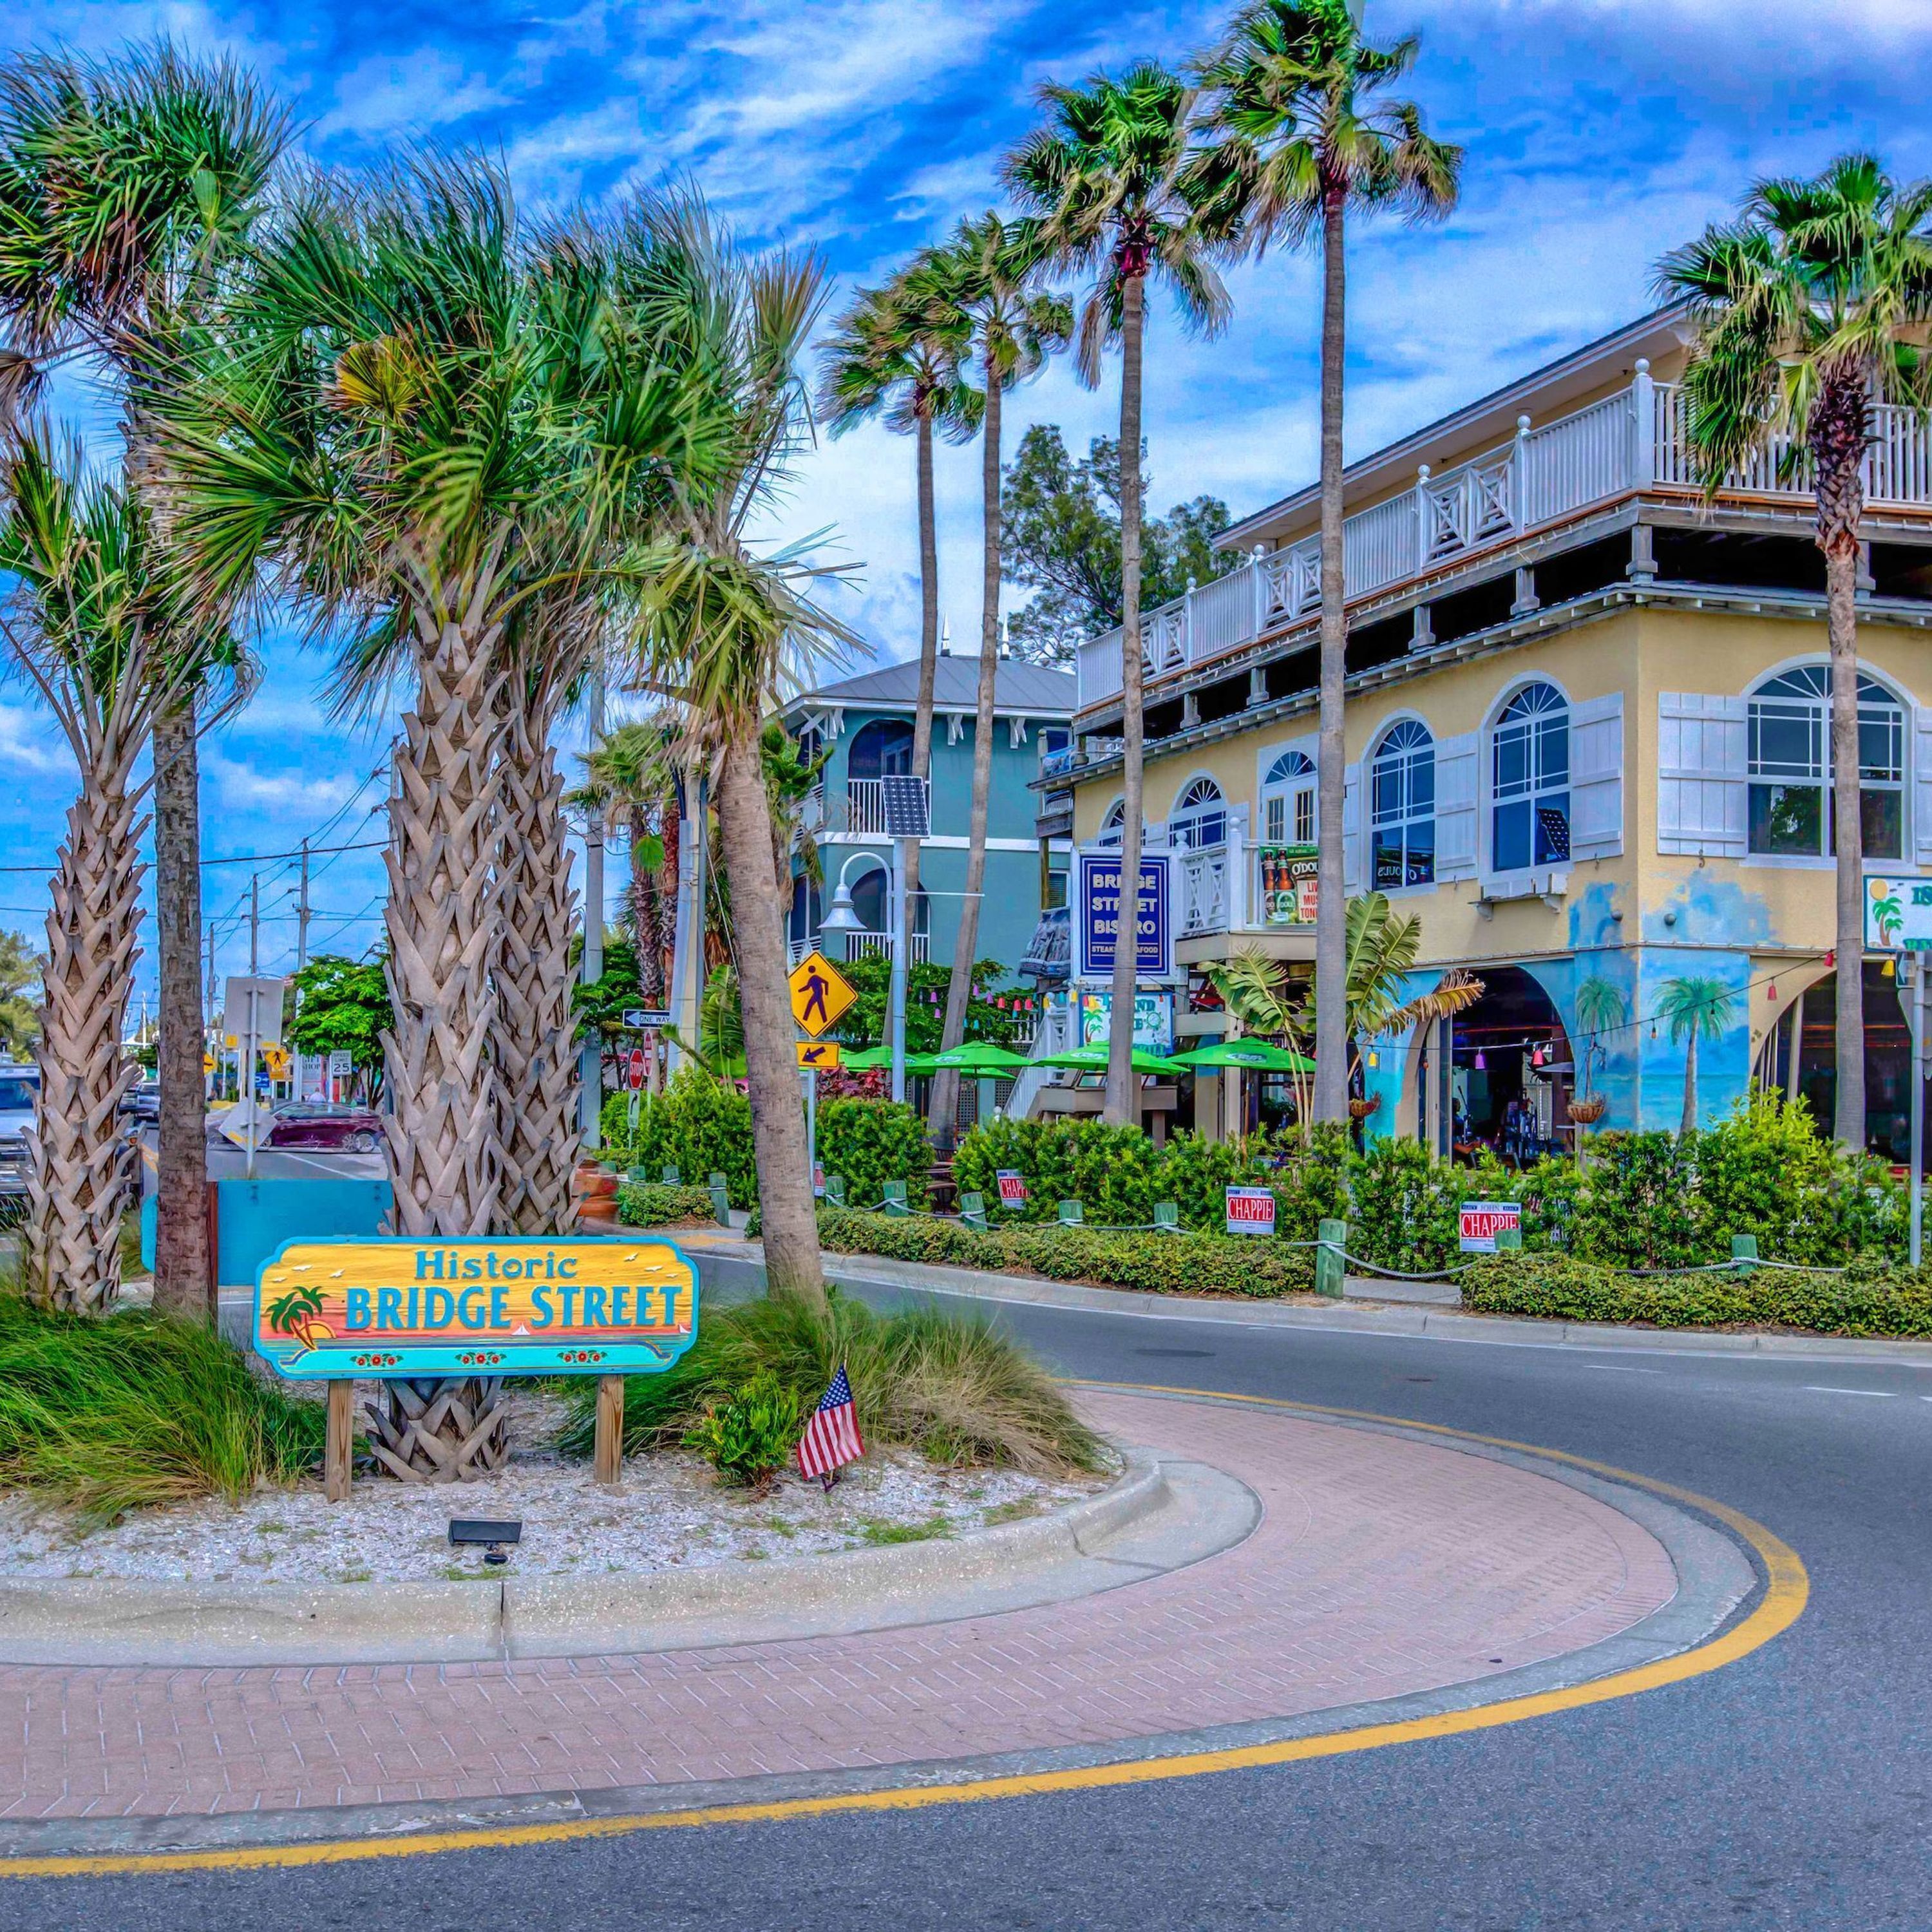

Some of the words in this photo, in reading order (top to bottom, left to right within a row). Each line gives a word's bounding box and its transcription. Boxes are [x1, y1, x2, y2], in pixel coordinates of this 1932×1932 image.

[1092, 874, 1157, 890] BRIGE
[1092, 896, 1157, 912] STET
[1094, 919, 1156, 934] BISRO
[334, 1063, 350, 1072] 25
[630, 1062, 643, 1076] STOP
[1229, 1198, 1273, 1220] CHAPPIE
[1461, 1214, 1517, 1236] CHAPPIE
[414, 1249, 578, 1280] Historic
[345, 1285, 513, 1330] BRIDGE
[530, 1285, 683, 1328] STREET
